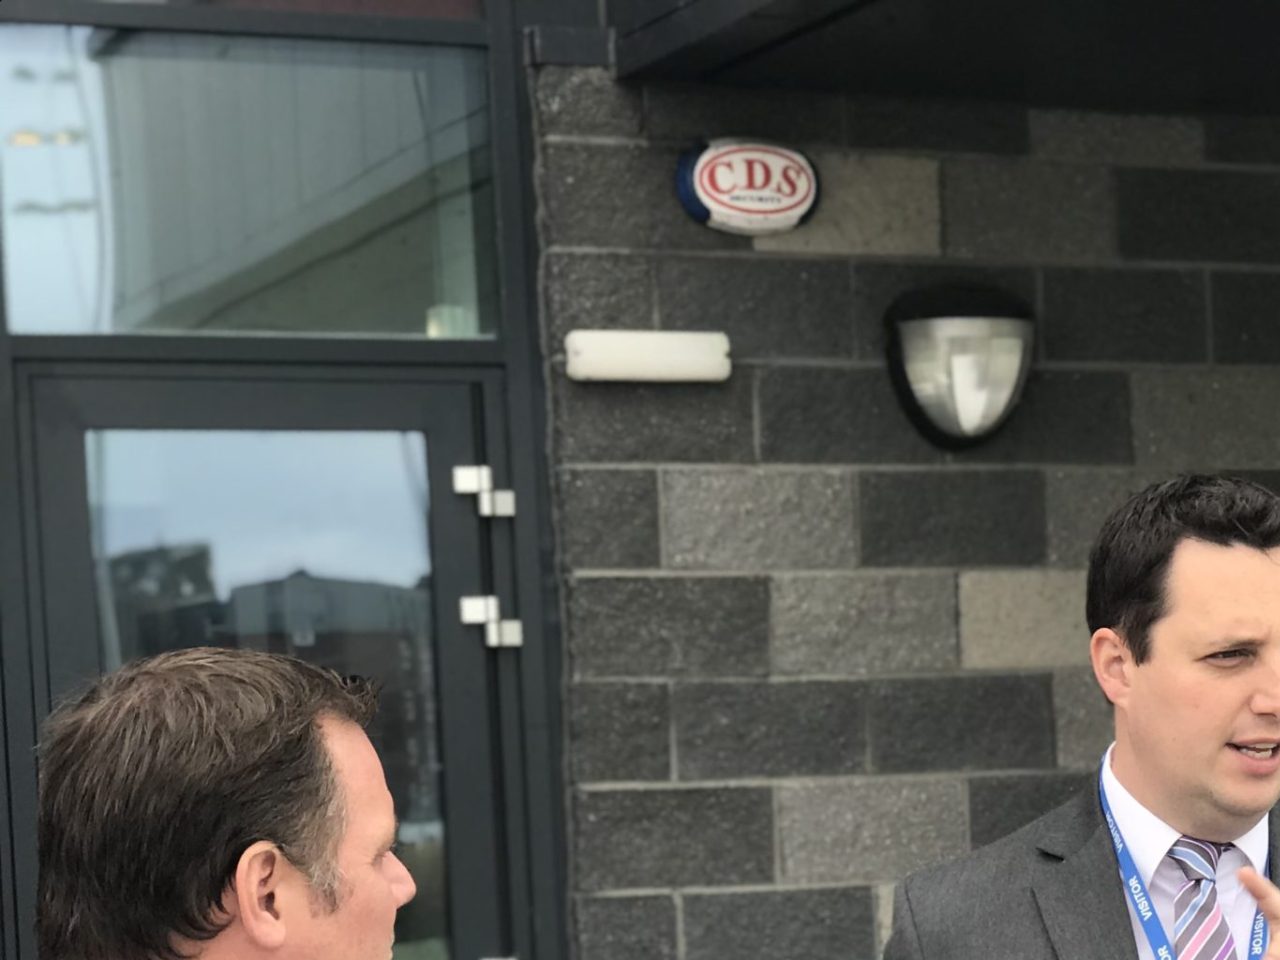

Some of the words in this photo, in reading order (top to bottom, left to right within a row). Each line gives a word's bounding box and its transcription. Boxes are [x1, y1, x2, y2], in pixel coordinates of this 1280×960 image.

[1104, 810, 1124, 853] VISITOR
[1128, 874, 1153, 921] VISITOR
[1251, 912, 1265, 956] VISITOR
